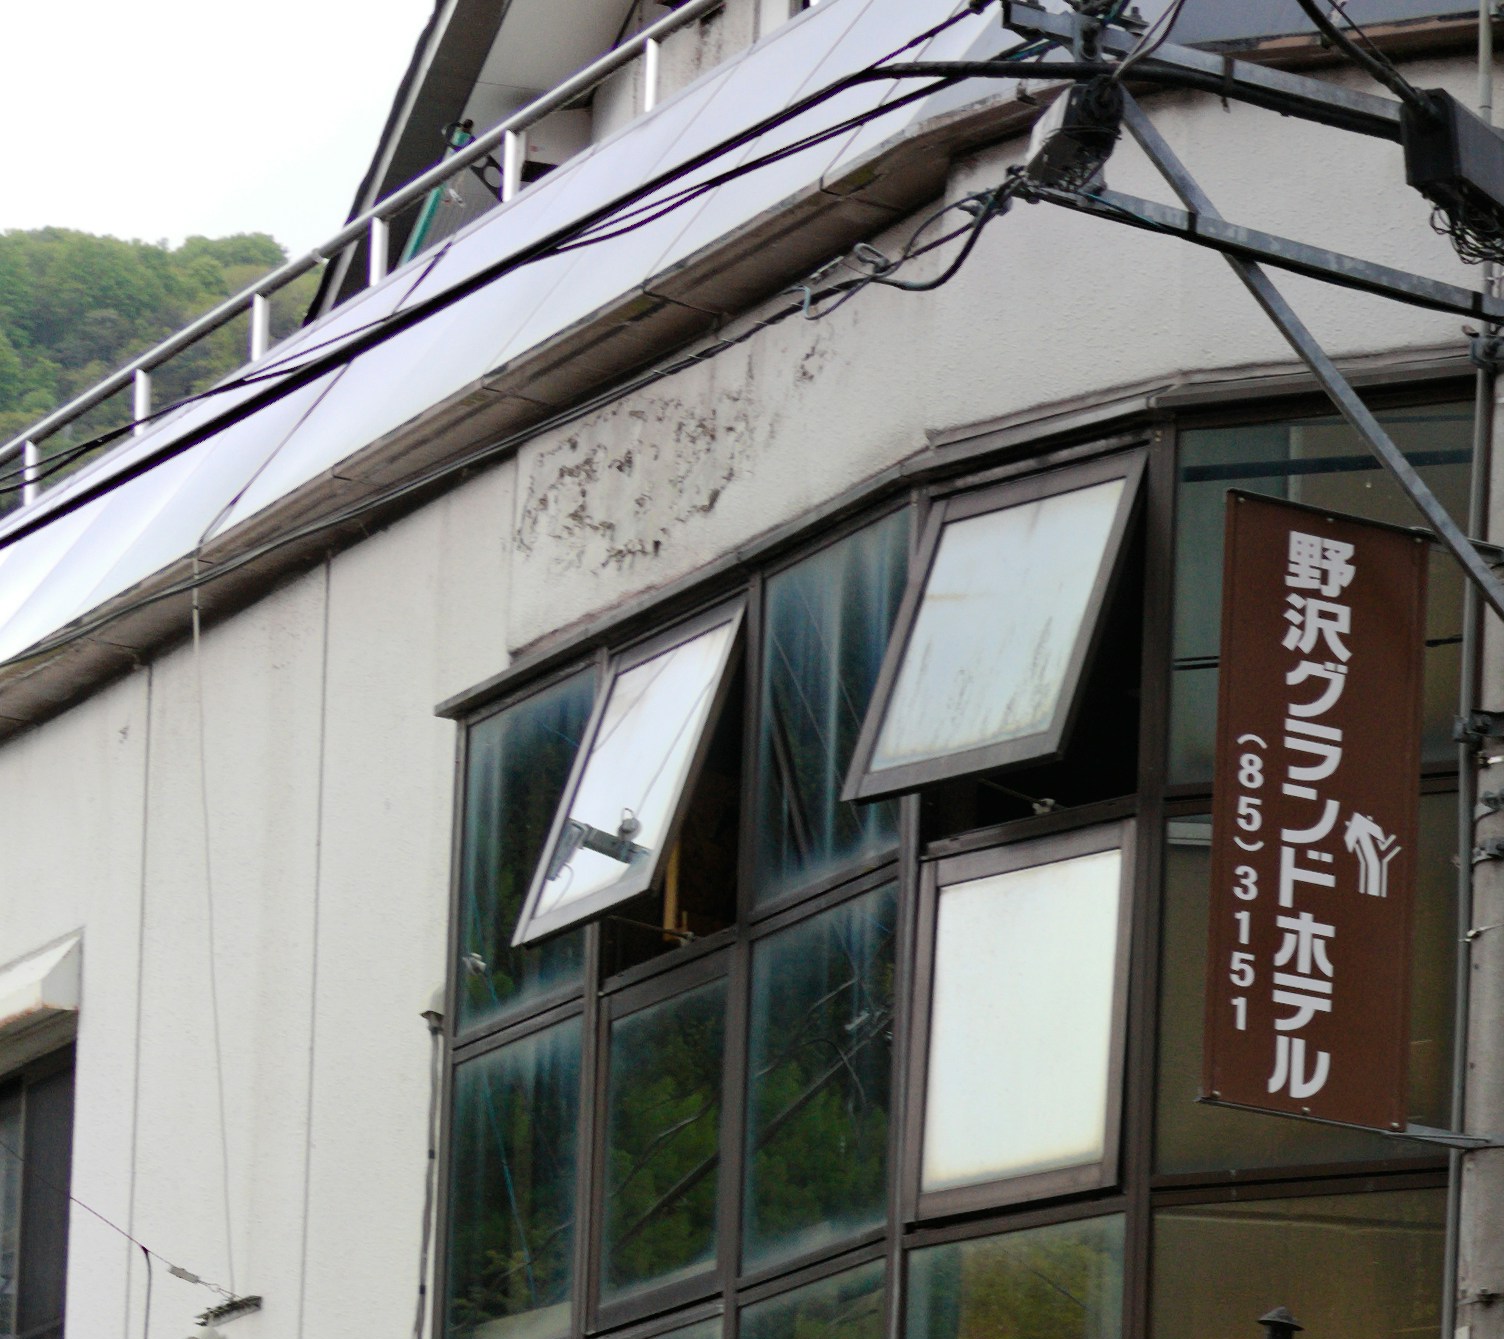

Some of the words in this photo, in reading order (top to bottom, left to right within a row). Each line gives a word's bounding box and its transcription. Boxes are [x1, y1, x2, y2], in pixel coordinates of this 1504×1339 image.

[1228, 732, 1268, 1031] (85)3151
[1267, 531, 1355, 1099] 野沢グランドホテル
